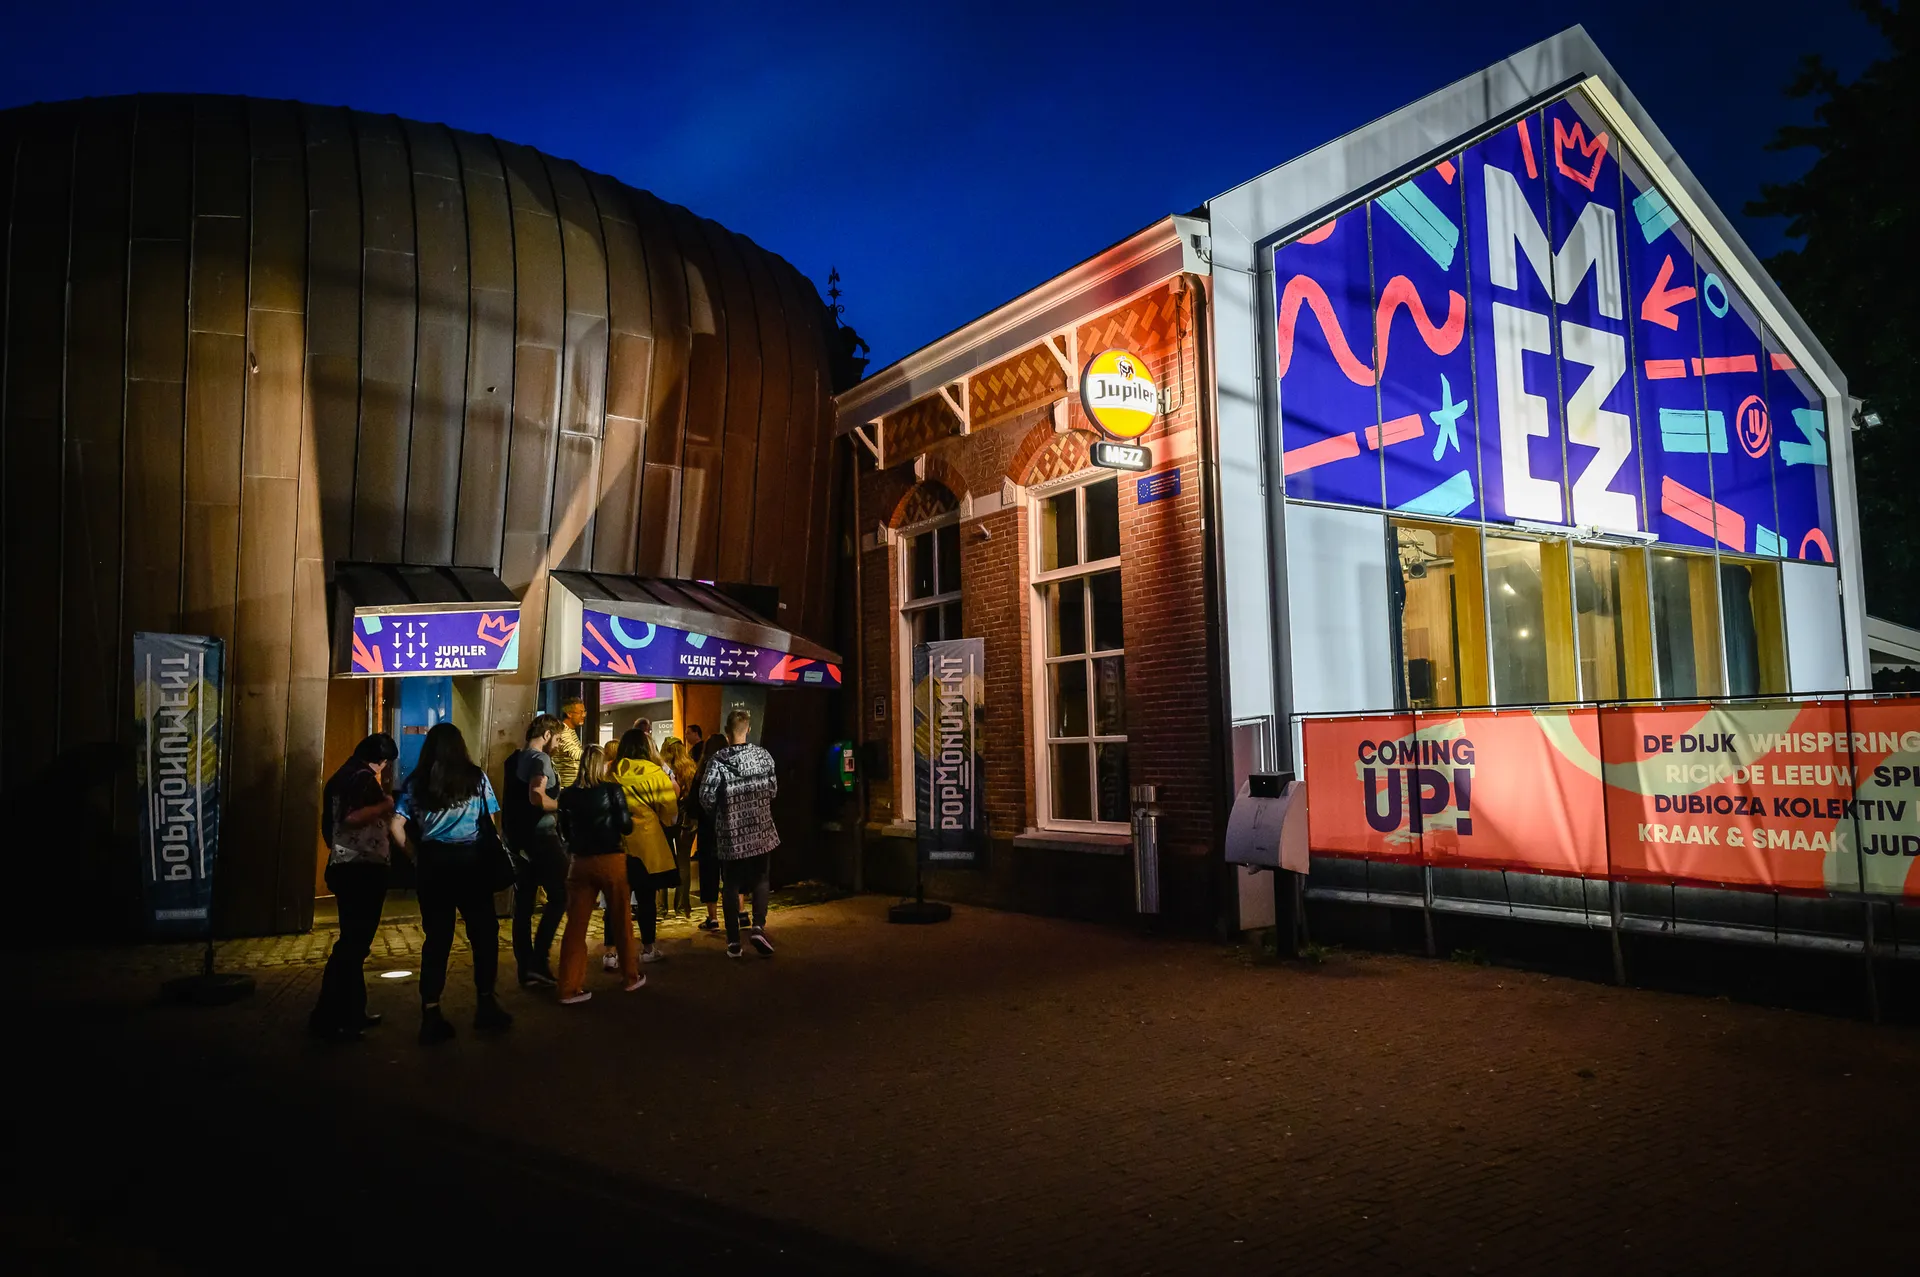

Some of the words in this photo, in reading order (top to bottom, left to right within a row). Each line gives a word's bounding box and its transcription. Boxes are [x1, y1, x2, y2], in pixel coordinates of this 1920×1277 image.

[1094, 379, 1154, 403] Jupiler
[1105, 445, 1144, 467] MEZZ
[434, 645, 487, 657] JUPILER
[680, 654, 716, 666] KLEINE
[434, 657, 468, 669] ZAAL
[688, 666, 715, 677] ZAAL
[935, 655, 963, 830] POPMONUMENT
[1357, 738, 1475, 765] COMING
[1643, 734, 1673, 753] DE
[1679, 733, 1736, 753] DIJK
[1748, 730, 1920, 753] WHISPERING
[1665, 764, 1725, 784] RICK
[1732, 764, 1765, 785] DE
[1771, 765, 1858, 787] LEEUW
[1363, 767, 1473, 836] UP!
[1654, 794, 1767, 817] DUBIOZA
[1773, 797, 1906, 822] KOLEKTIV
[1638, 823, 1720, 846] KRAAK
[1726, 828, 1745, 848] &
[1752, 828, 1849, 853] SMAAK
